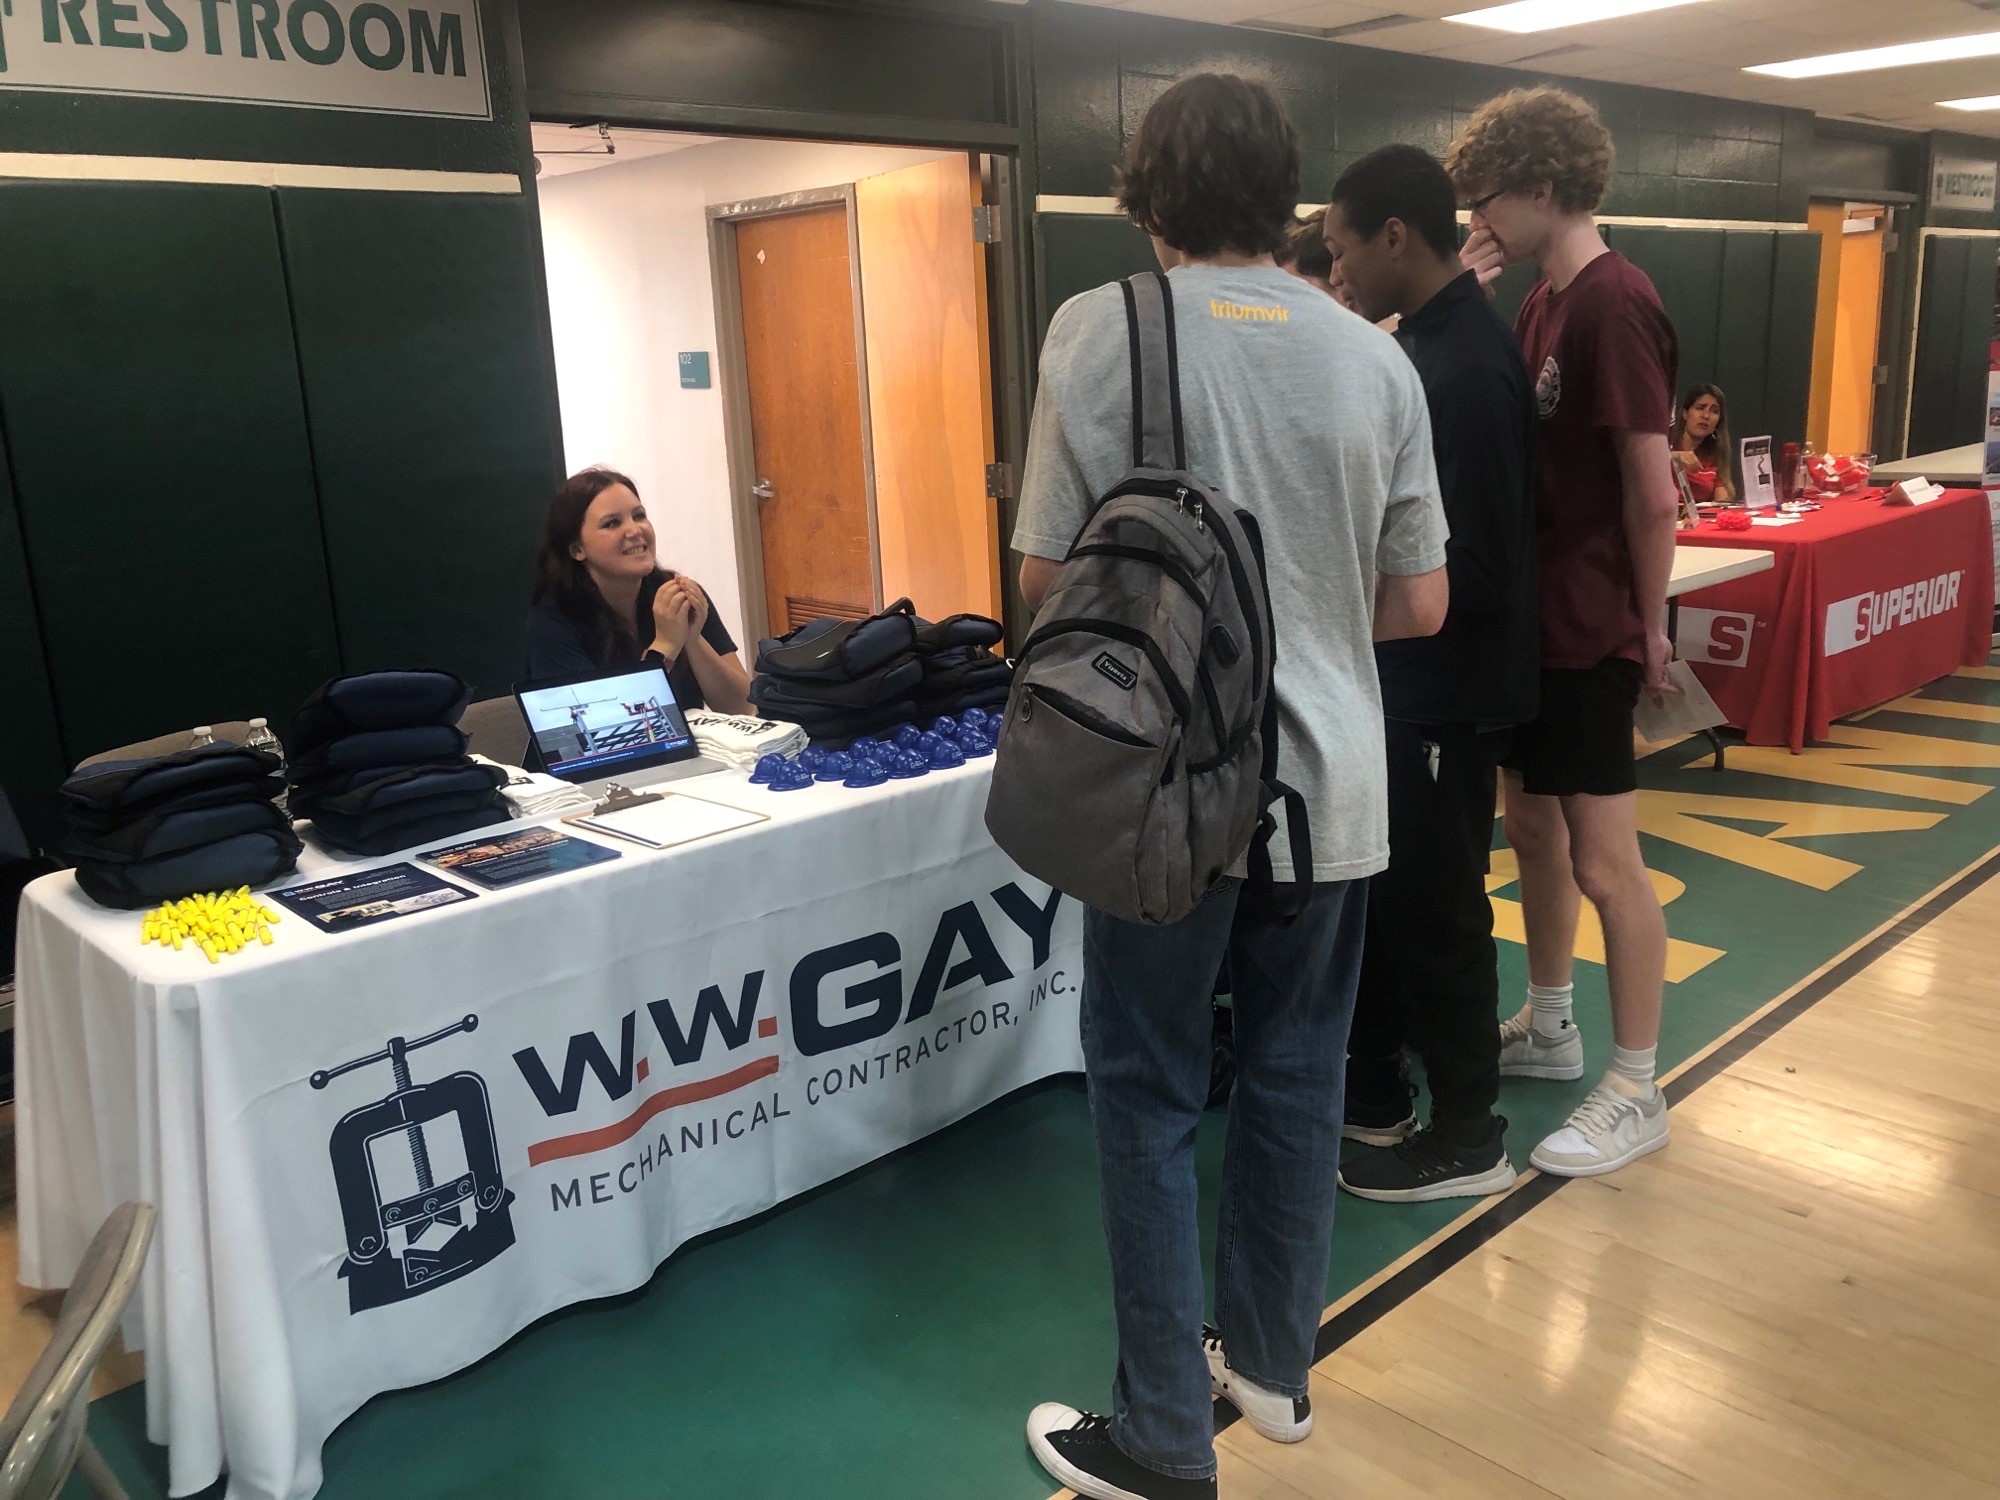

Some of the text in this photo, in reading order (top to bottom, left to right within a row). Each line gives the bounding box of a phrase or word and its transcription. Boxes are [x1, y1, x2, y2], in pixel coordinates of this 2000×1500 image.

[42, 0, 468, 78] RESTROOM
[1210, 300, 1289, 321] triumvir
[1855, 570, 1961, 641] SUPERIOR
[1708, 615, 1747, 661] S
[299, 888, 342, 901] Controls
[353, 874, 407, 889] Integration
[551, 970, 1077, 1212] MECHANICAL CONTRACTOR, INC.
